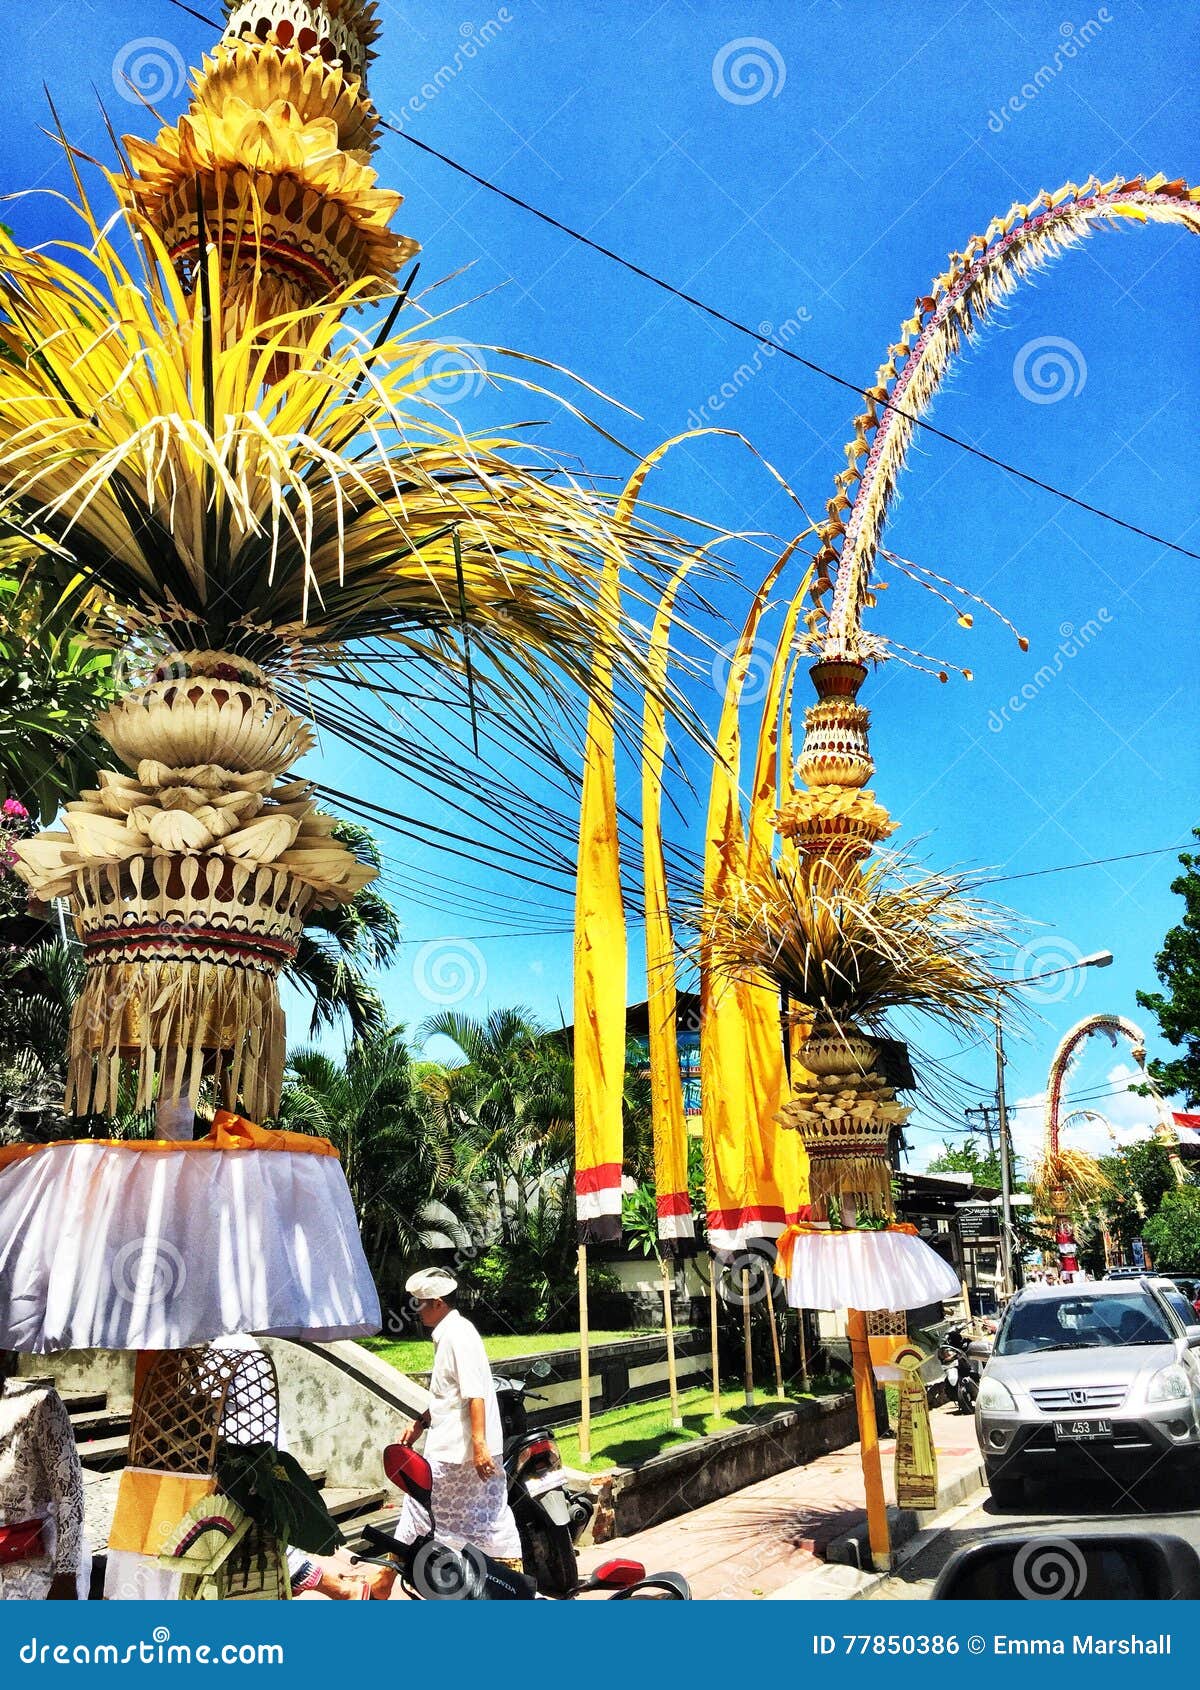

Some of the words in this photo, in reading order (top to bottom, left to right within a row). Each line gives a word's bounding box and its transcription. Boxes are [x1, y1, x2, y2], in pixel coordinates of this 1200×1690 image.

[1056, 1423, 1064, 1435] N
[1072, 1421, 1090, 1434] 453
[1098, 1420, 1111, 1433] AL
